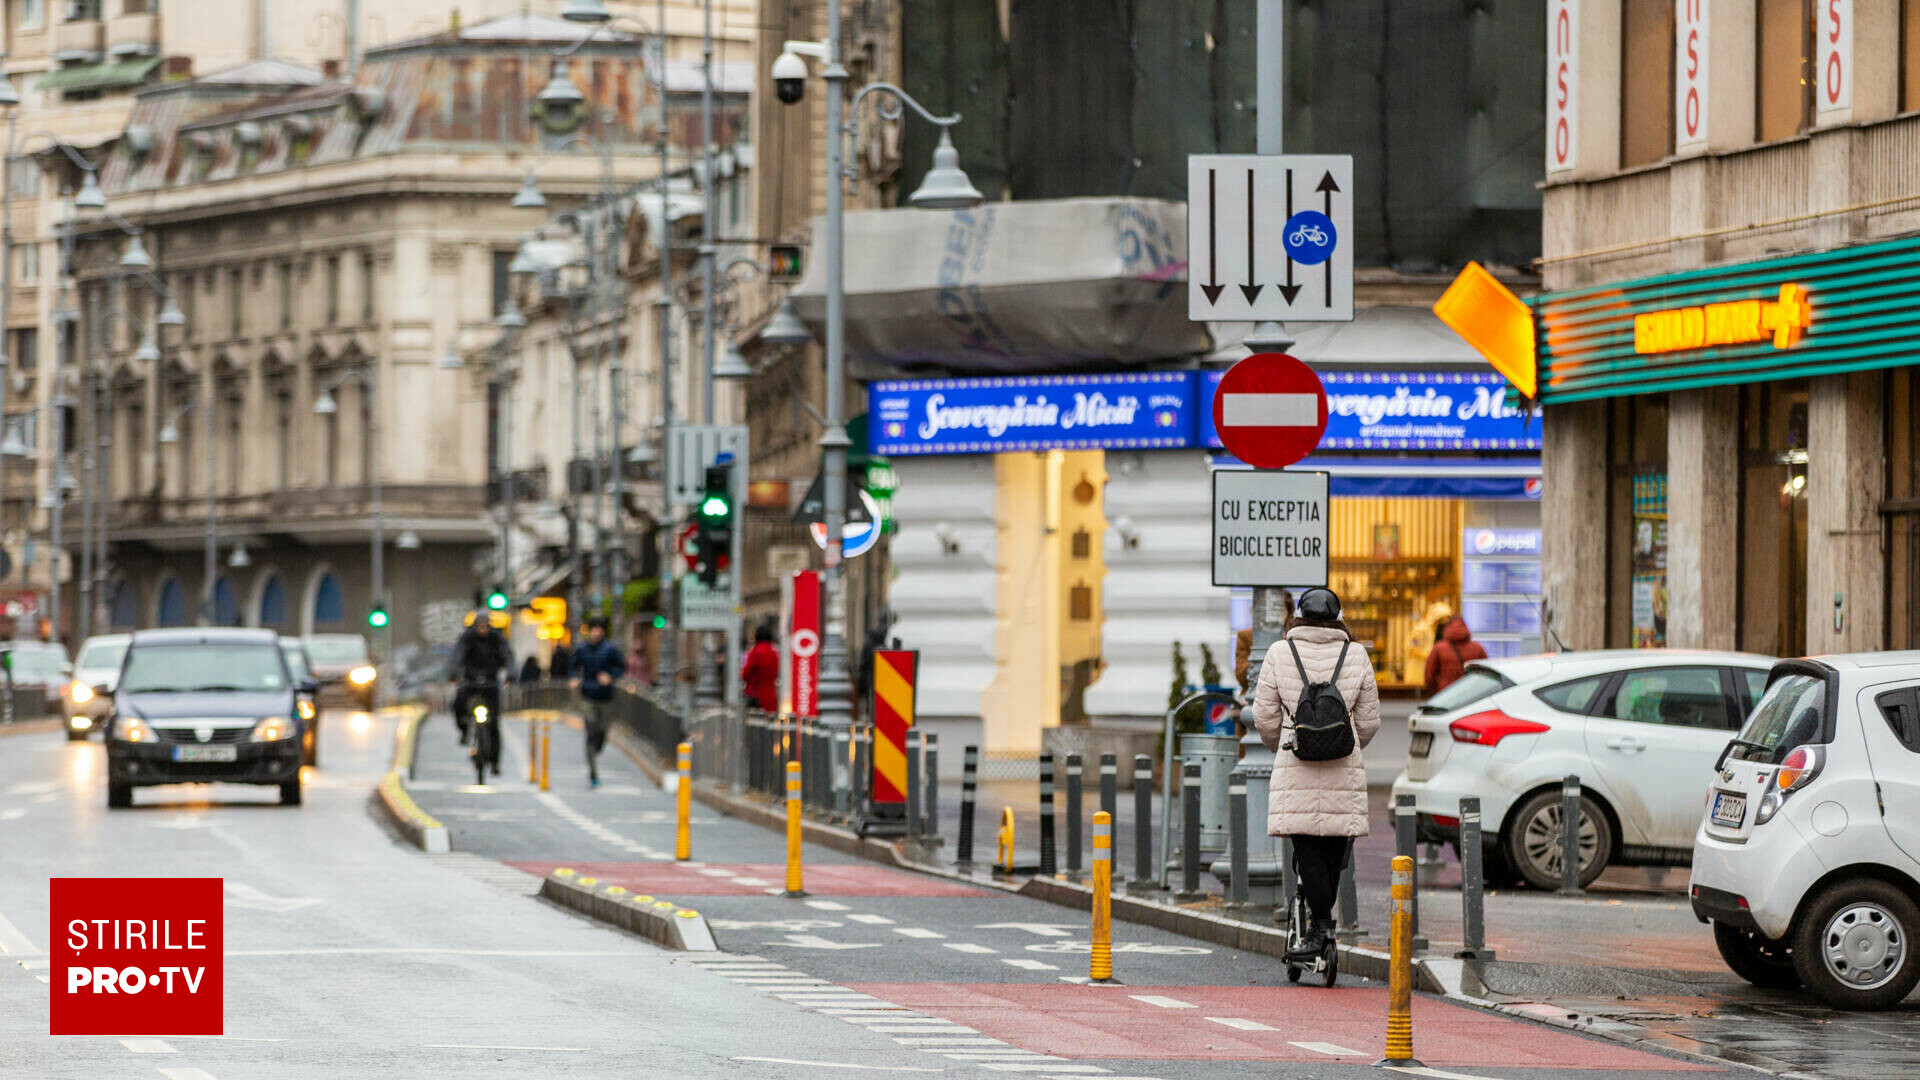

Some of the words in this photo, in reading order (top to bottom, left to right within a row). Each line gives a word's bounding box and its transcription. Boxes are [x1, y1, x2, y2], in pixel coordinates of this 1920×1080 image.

[1327, 386, 1453, 425] vergăria
[1221, 500, 1240, 520] CU
[1220, 536, 1321, 557] BICICLETELOR
